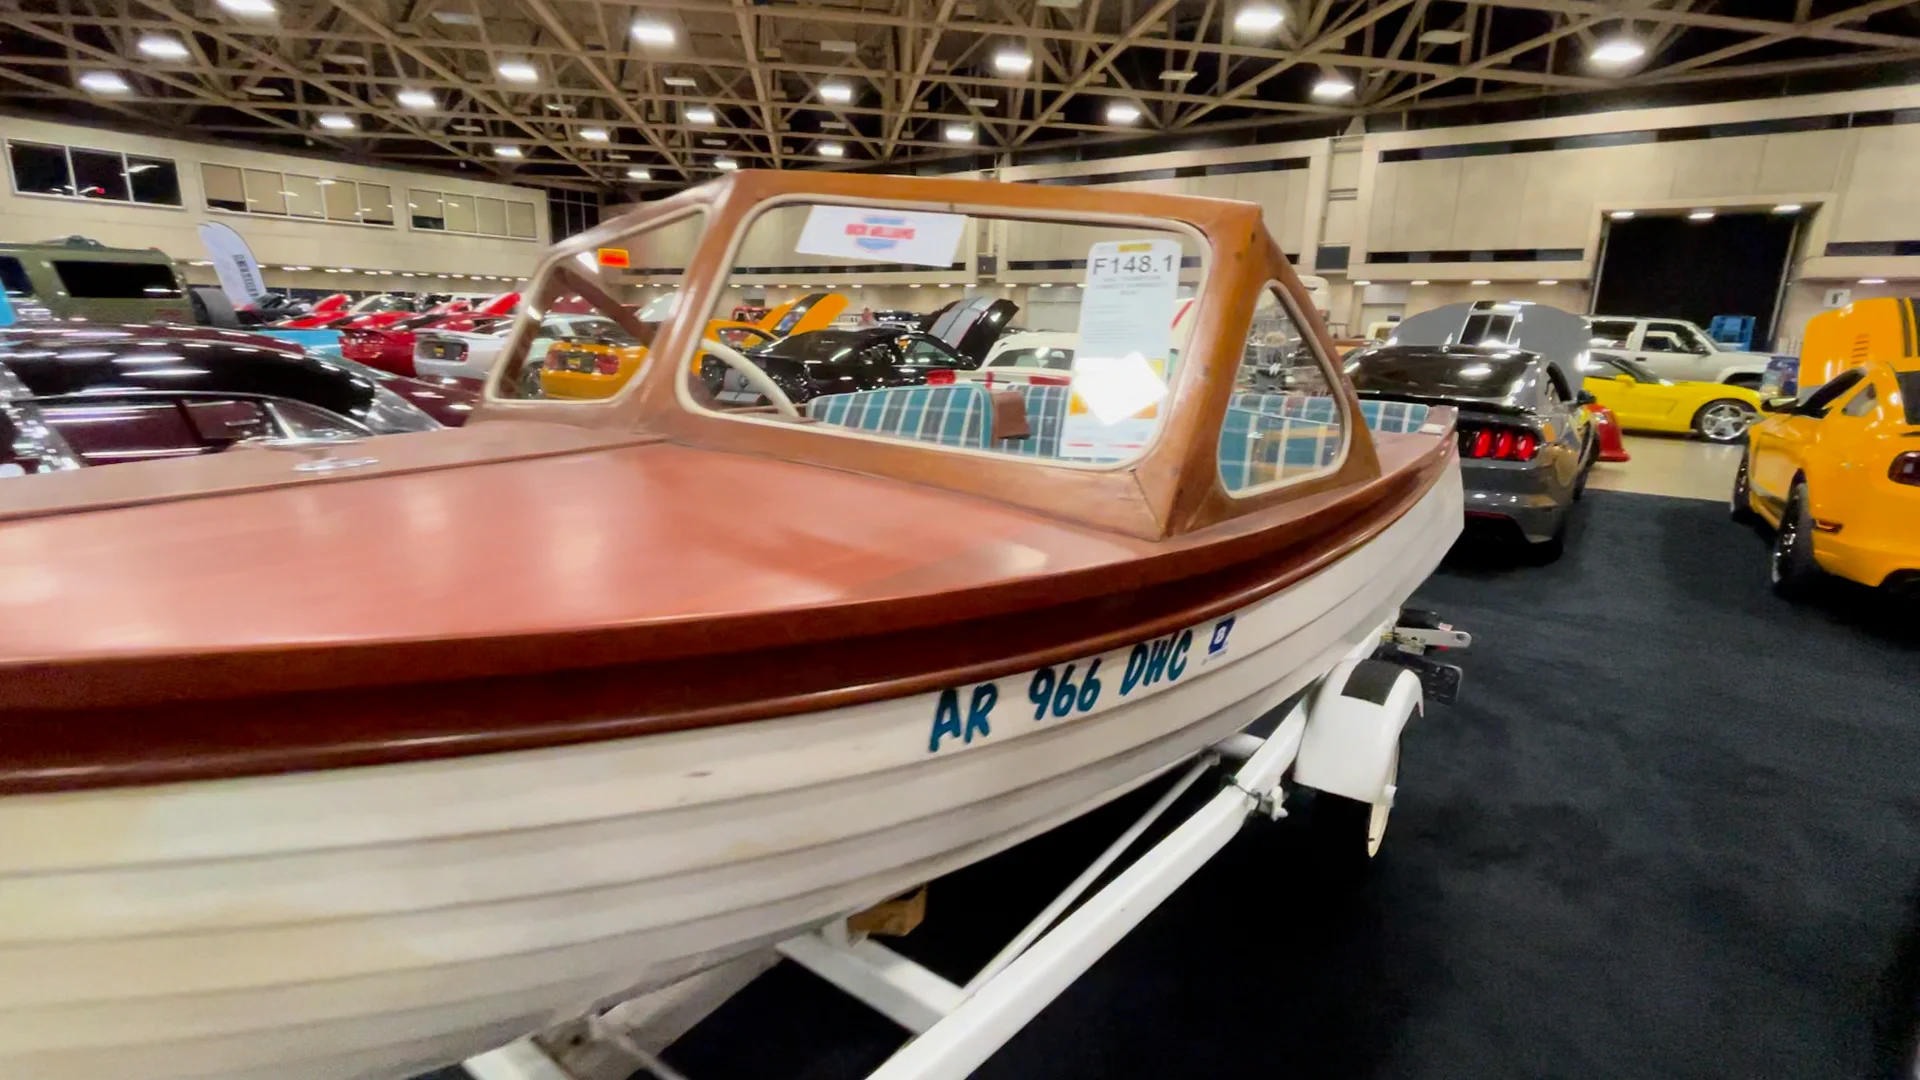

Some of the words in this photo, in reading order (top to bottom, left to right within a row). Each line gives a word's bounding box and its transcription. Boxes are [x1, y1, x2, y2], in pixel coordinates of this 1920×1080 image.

[1092, 254, 1174, 275] F148.1
[928, 682, 998, 752] AR
[1029, 659, 1102, 720] 966
[1118, 629, 1194, 696] DWC
